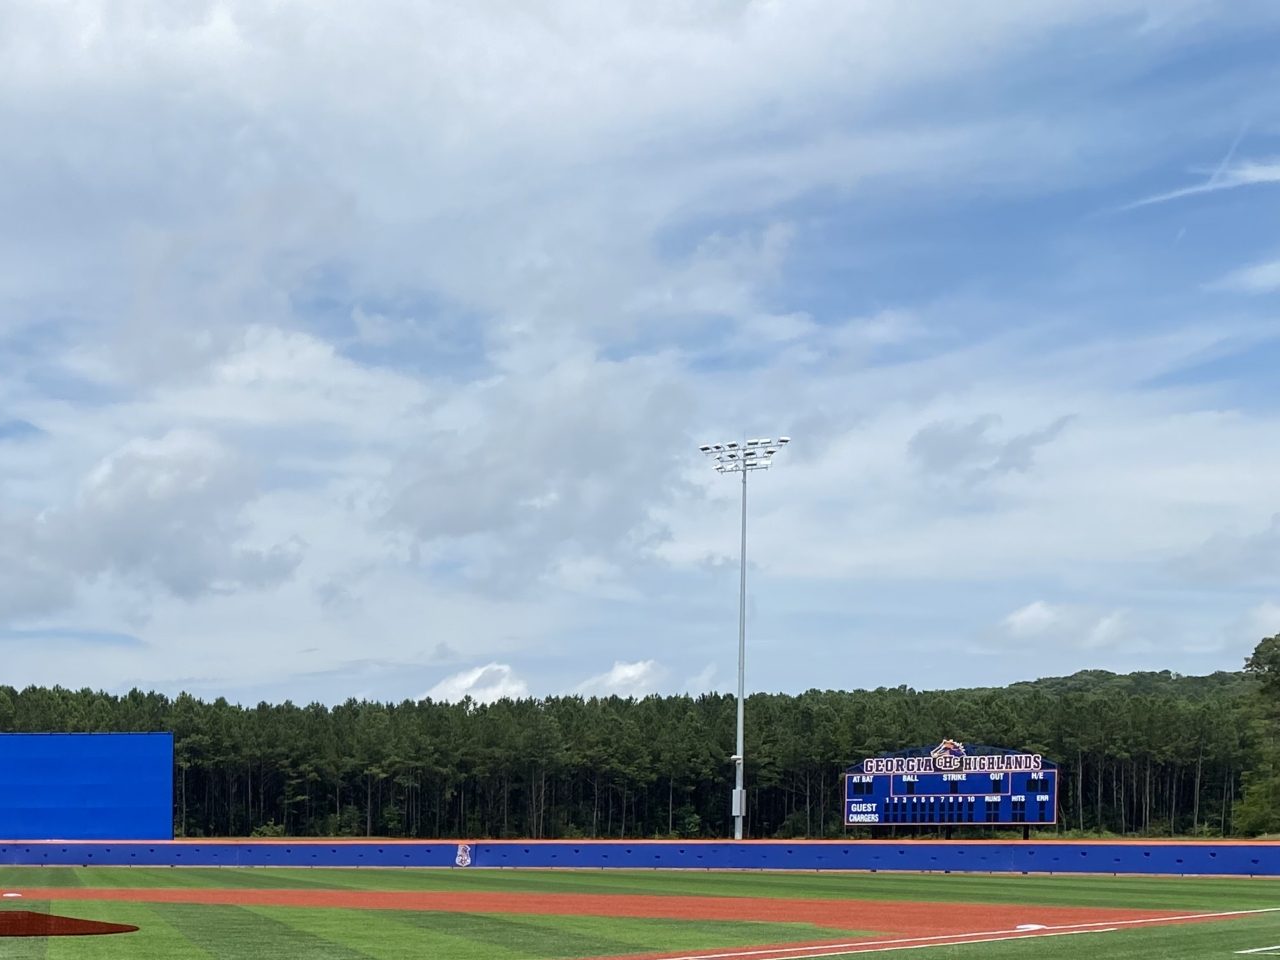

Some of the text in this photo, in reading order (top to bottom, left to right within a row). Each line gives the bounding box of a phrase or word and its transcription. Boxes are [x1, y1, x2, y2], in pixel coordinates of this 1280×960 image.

[864, 758, 934, 773] GEORGIA
[936, 755, 961, 770] GHC
[963, 755, 1041, 771] HIGHLANDS
[851, 803, 877, 812] GUEST
[849, 814, 879, 823] CHARGERS
